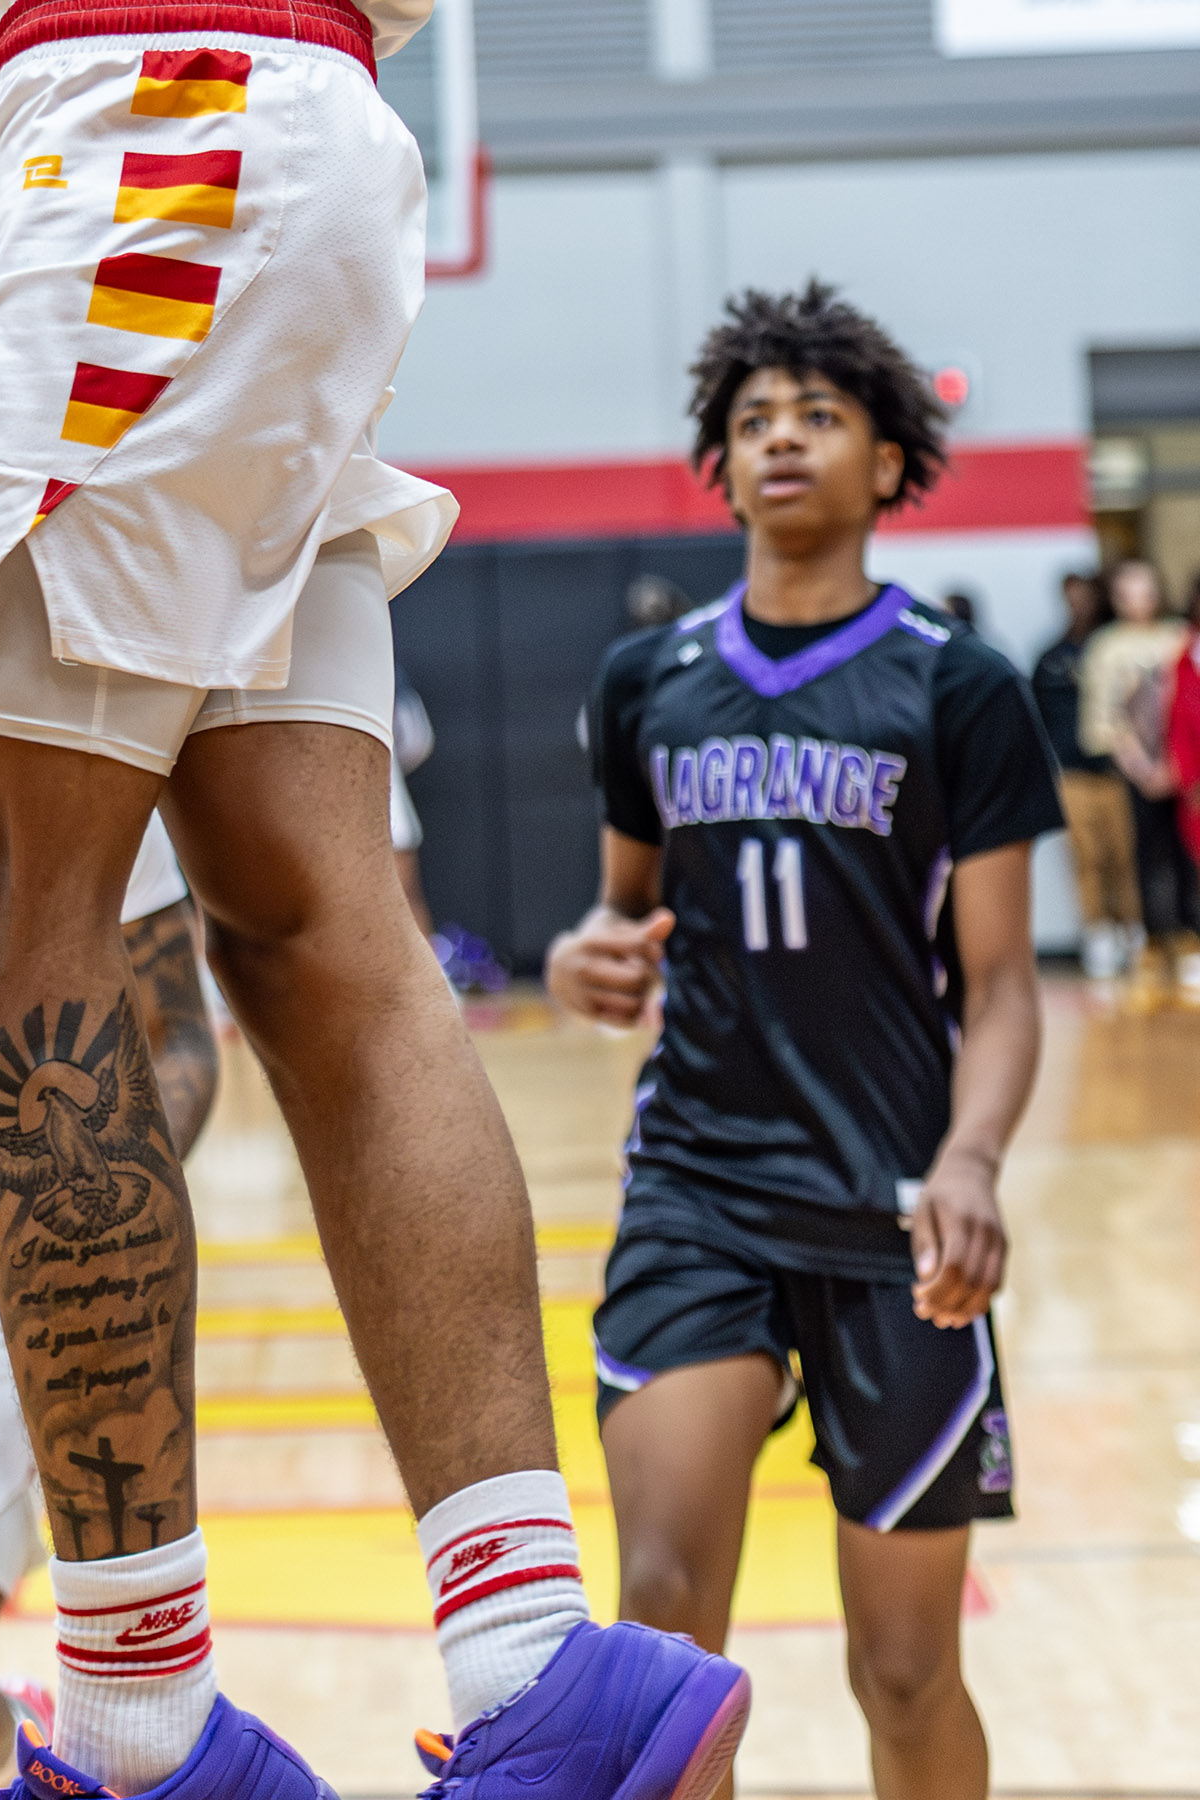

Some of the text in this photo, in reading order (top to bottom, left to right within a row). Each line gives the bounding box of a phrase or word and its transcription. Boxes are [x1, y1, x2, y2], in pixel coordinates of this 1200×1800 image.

[650, 733, 907, 837] LAGRANGE
[736, 837, 808, 952] 11
[449, 1536, 508, 1576] NIKE
[133, 1600, 195, 1632] NIKE
[29, 1760, 87, 1796] BOOK
